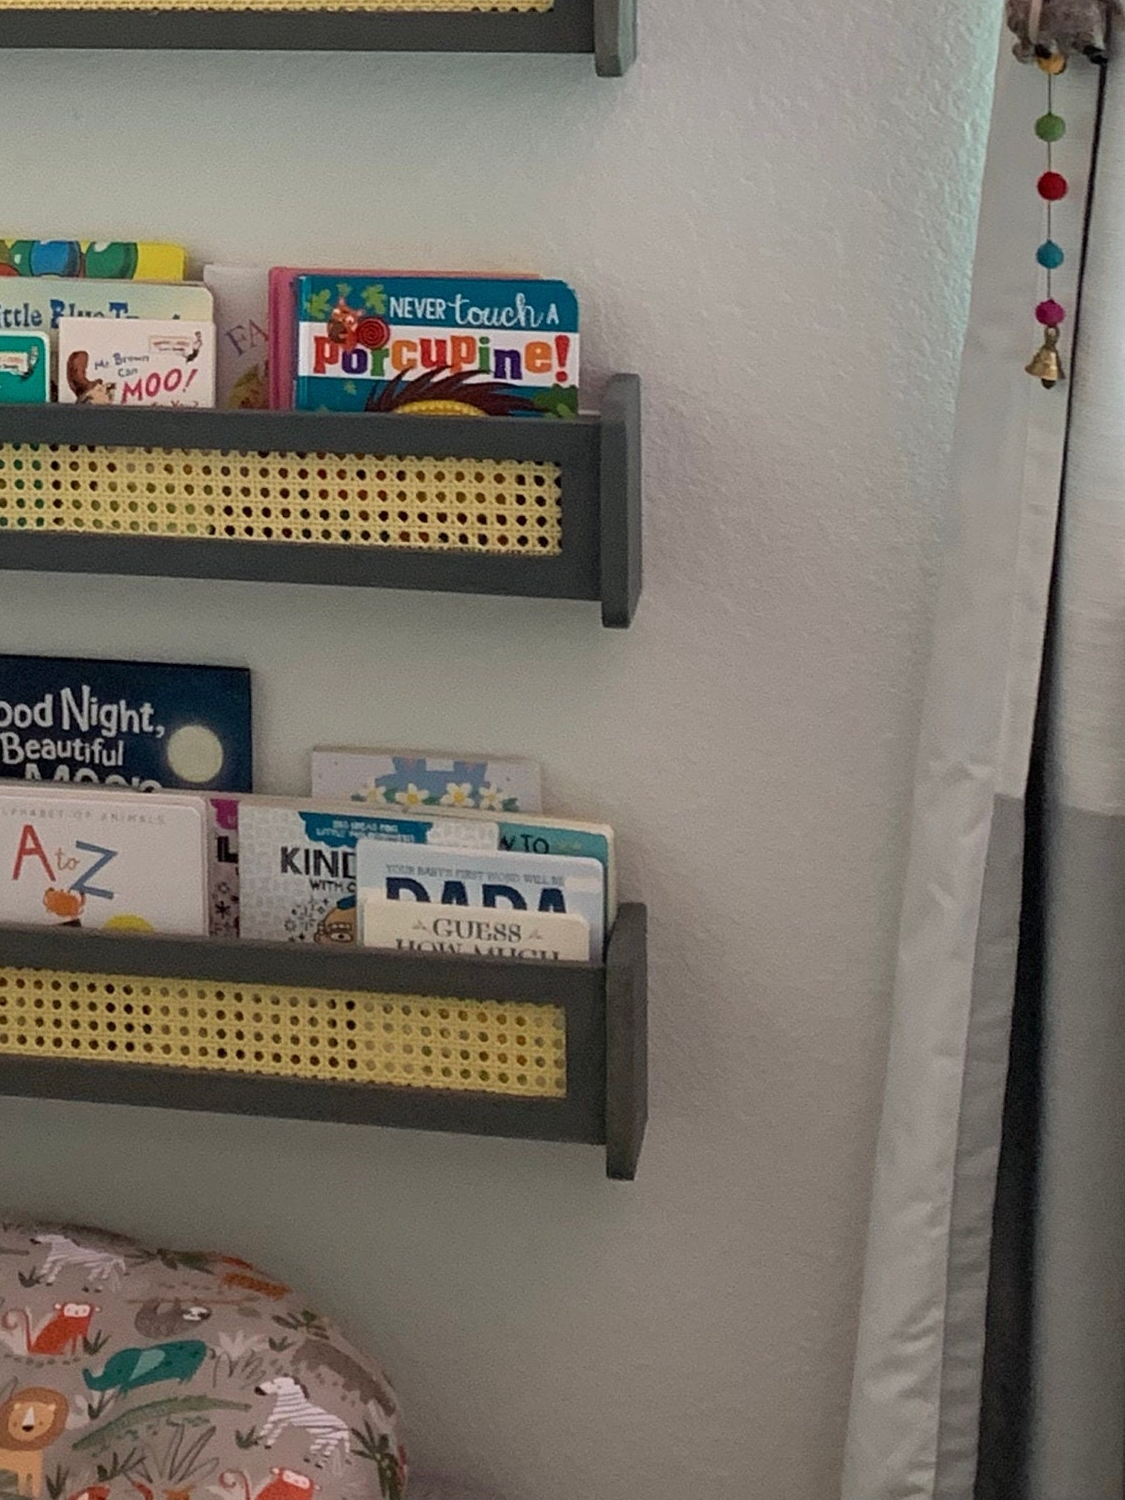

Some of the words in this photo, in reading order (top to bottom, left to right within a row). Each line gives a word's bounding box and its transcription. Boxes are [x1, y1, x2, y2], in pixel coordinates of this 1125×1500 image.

[389, 296, 445, 320] NEVER
[449, 292, 546, 329] touch
[546, 303, 560, 325] A
[113, 352, 150, 366] Brown
[121, 367, 199, 404] MOO!
[60, 684, 166, 738] Night,
[0, 731, 124, 766] Beautiful
[12, 824, 56, 882] A
[55, 848, 81, 871] to
[68, 840, 118, 900] Z
[432, 918, 521, 943] GUESS
